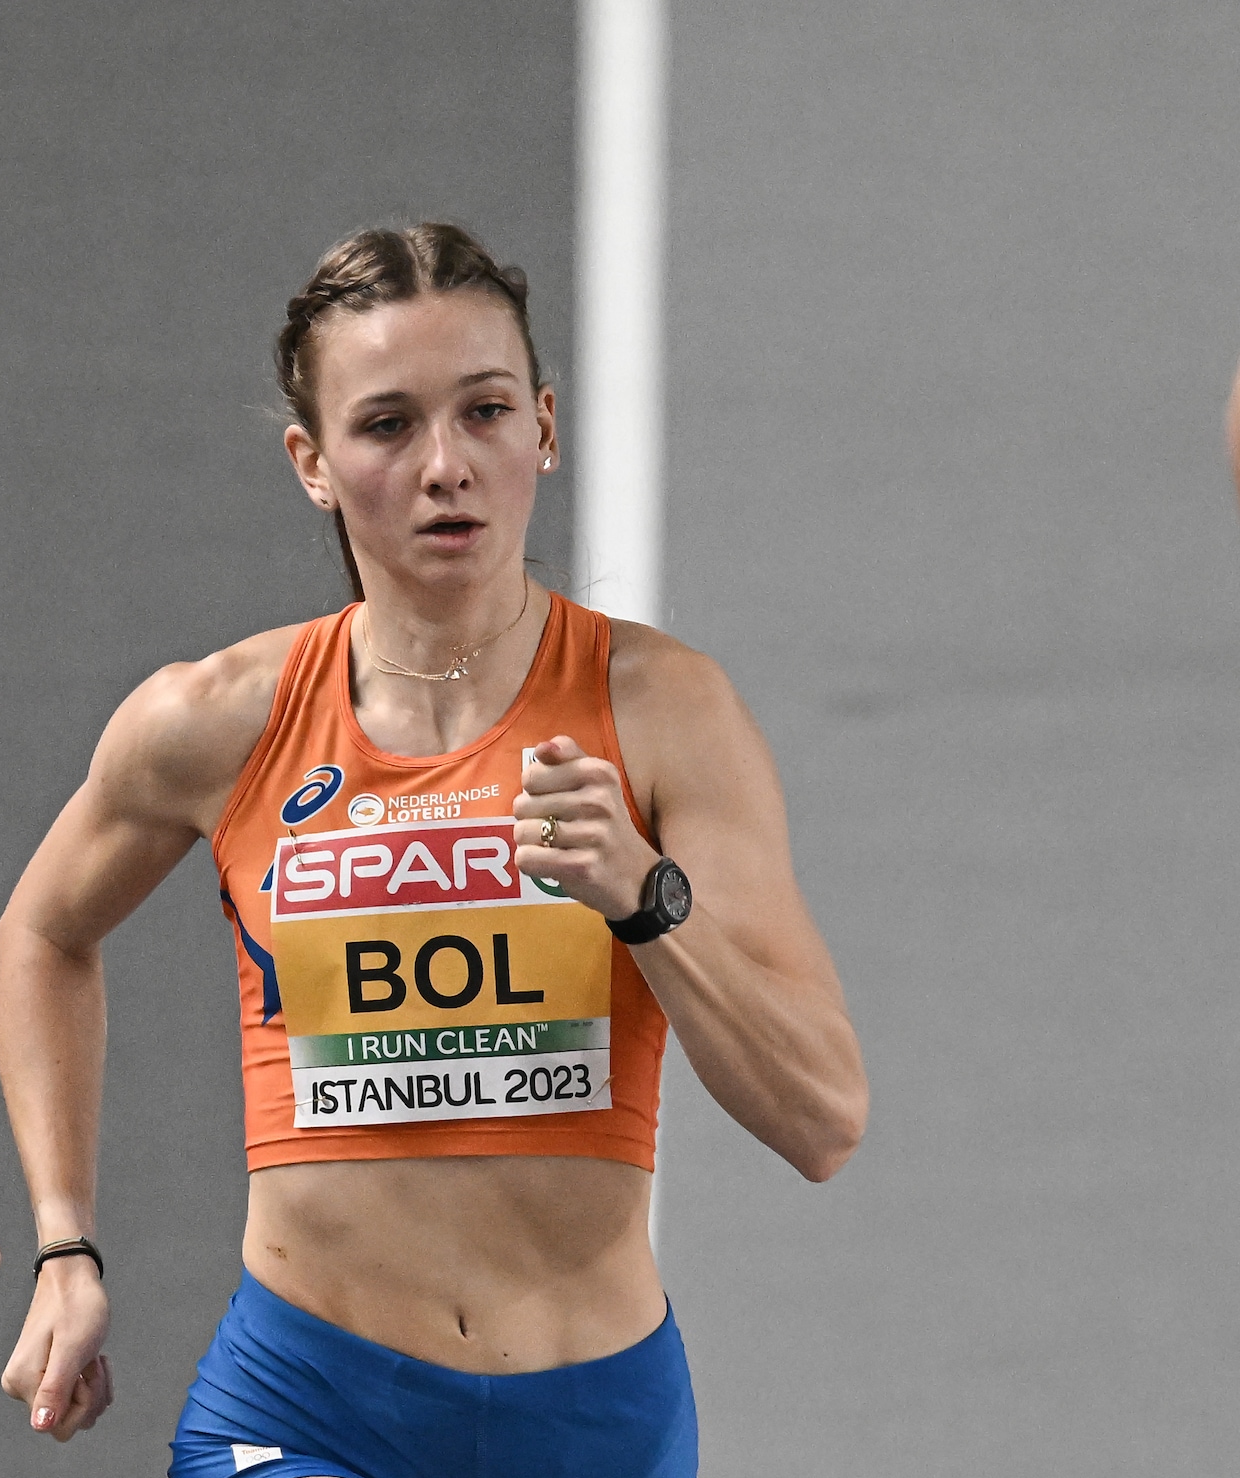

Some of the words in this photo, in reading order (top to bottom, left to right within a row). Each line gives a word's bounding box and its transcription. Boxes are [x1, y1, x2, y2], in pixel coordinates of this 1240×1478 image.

[387, 804, 461, 823] LOTERIJ
[388, 784, 500, 809] NEDERLANDSE
[284, 836, 513, 903] SPAR
[345, 933, 544, 1014] BOL
[348, 1038, 353, 1061] I
[362, 1032, 426, 1060] RUN
[311, 1071, 495, 1115] ISTANBUL
[504, 1064, 592, 1102] 2023
